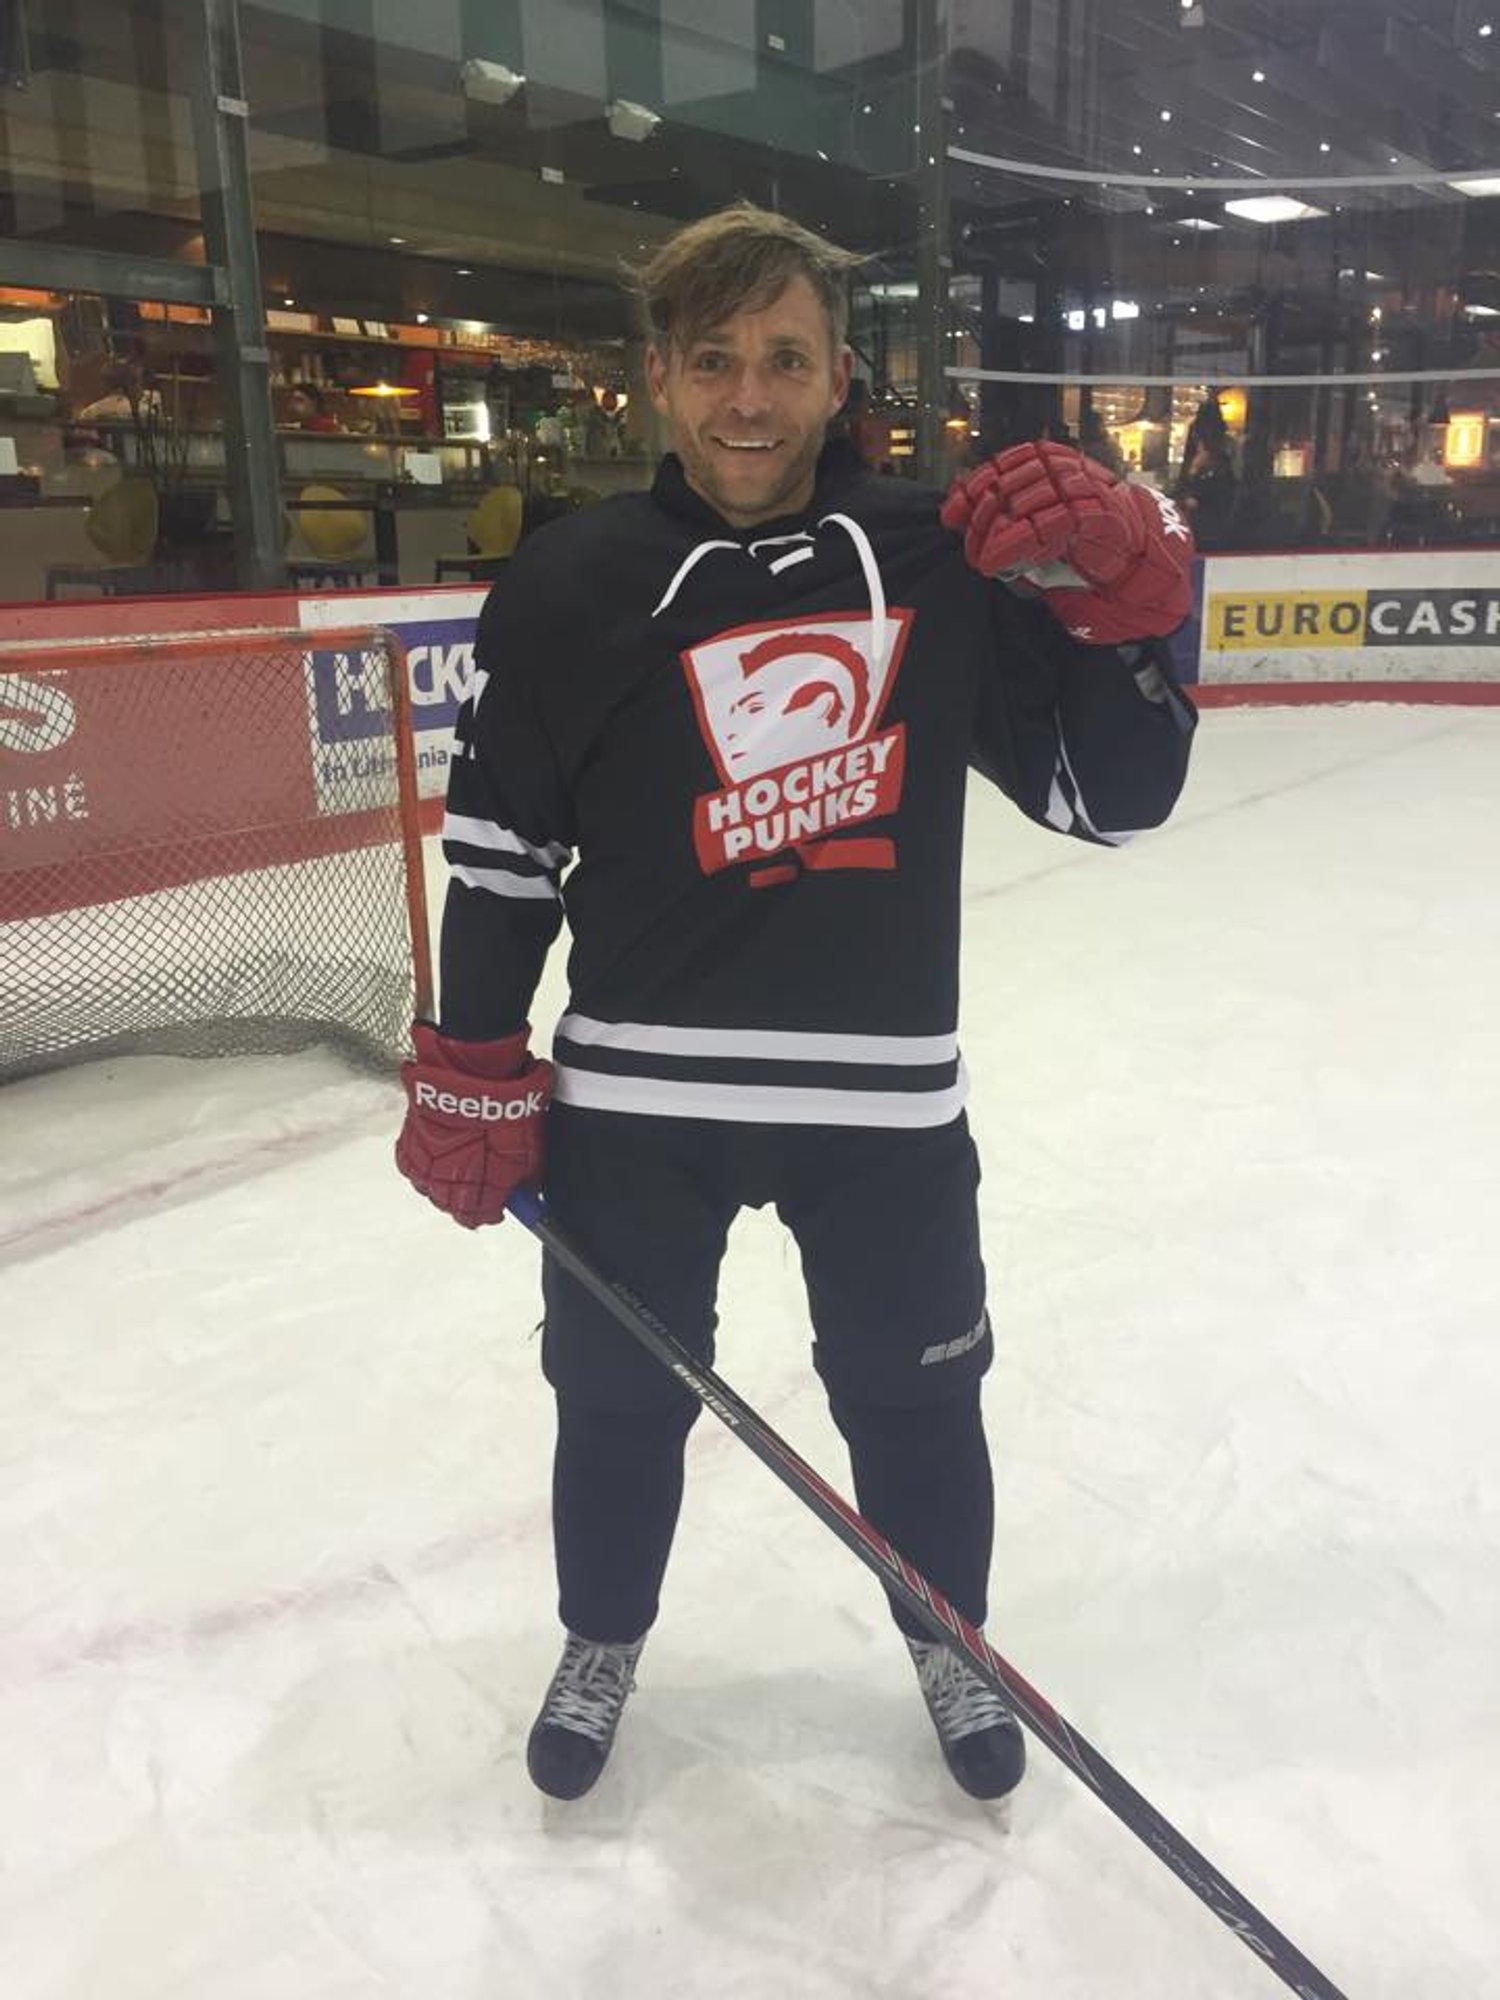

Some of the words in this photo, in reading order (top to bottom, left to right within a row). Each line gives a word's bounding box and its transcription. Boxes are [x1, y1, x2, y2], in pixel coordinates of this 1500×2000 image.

[707, 735, 898, 833] HOCKEY
[722, 779, 878, 861] PUNKS
[415, 1081, 543, 1121] Reebok
